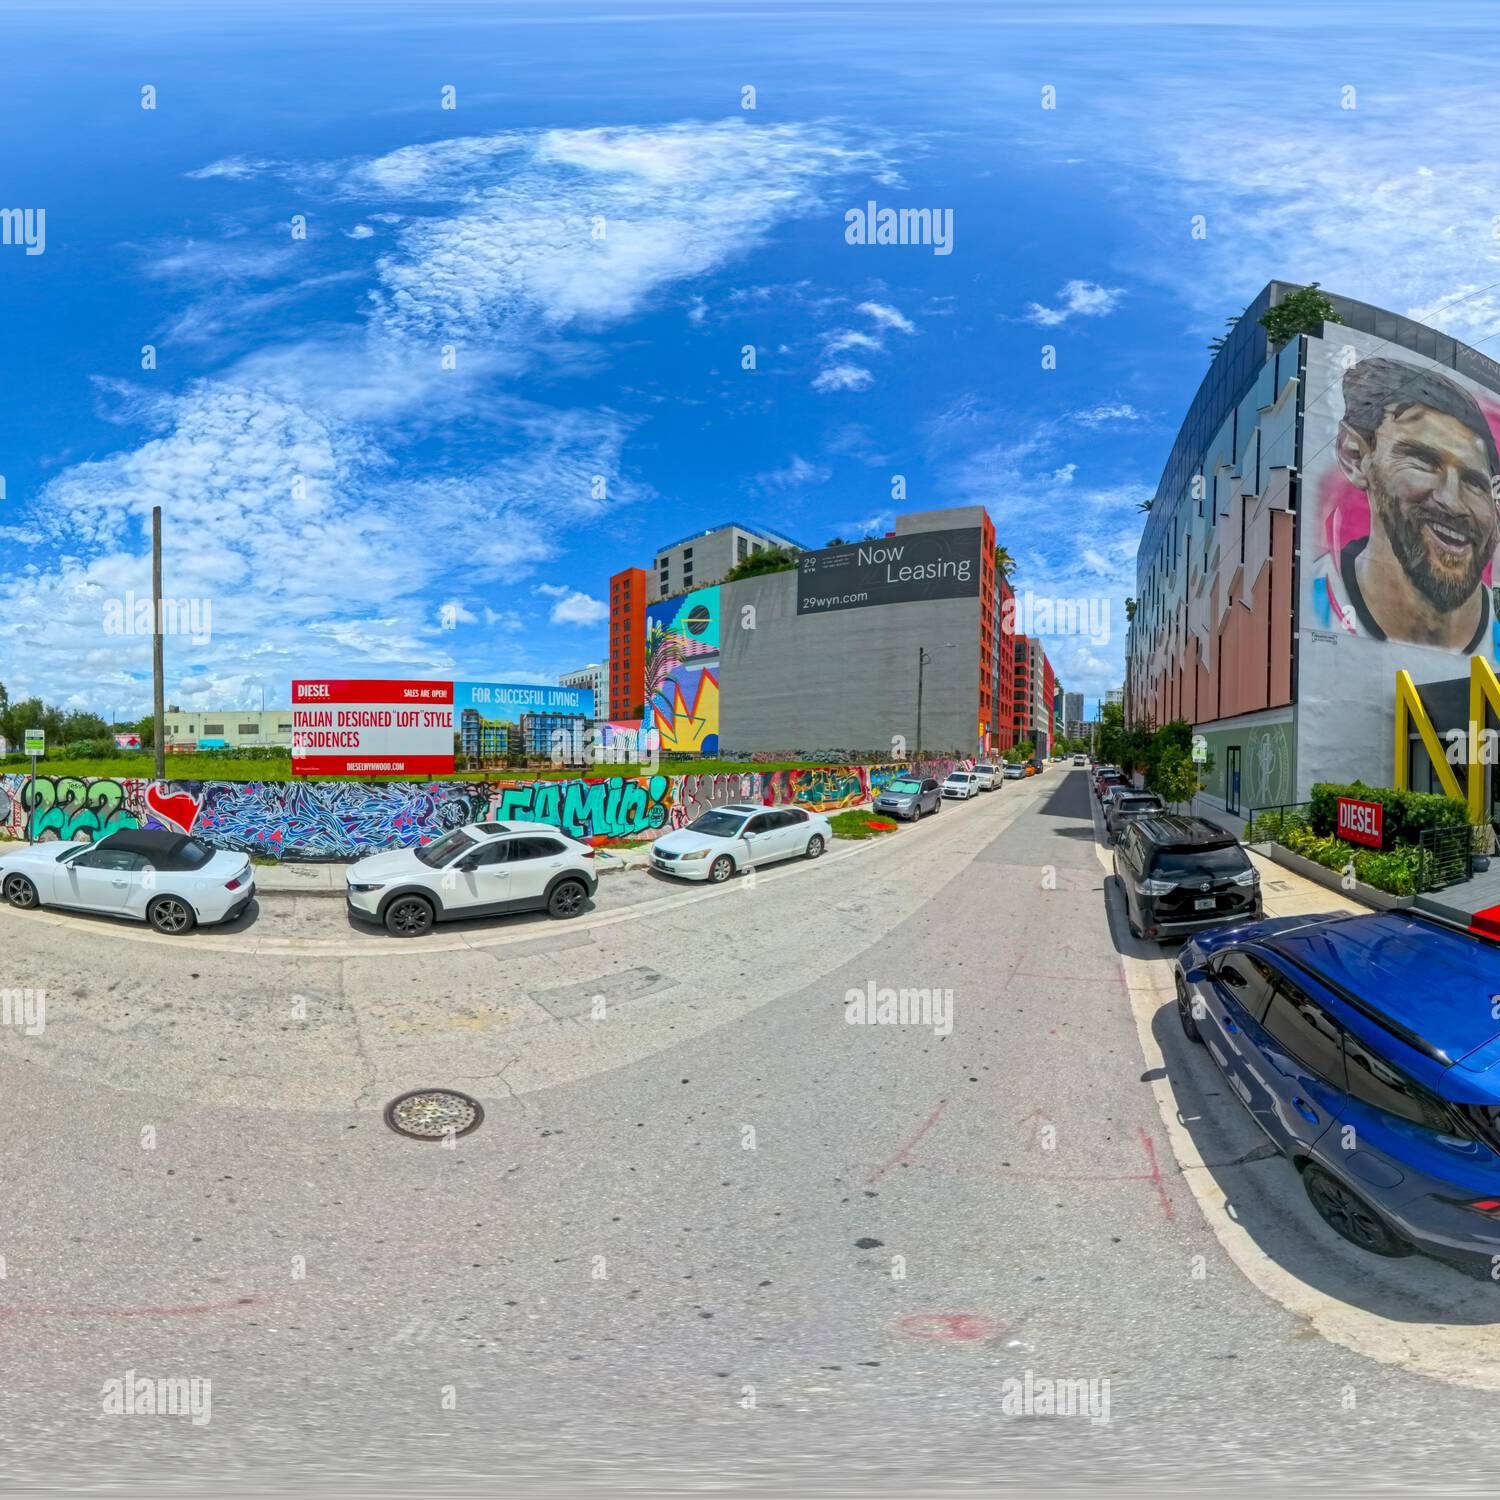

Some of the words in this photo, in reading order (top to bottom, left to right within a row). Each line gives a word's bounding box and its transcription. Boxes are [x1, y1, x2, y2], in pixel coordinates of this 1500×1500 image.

[804, 557, 817, 568] 29
[858, 546, 905, 567] Now
[887, 558, 971, 583] Leasing
[802, 591, 868, 609] 29wyn.com
[298, 685, 330, 697] DIESEL
[404, 689, 419, 698] SALES
[431, 690, 448, 698] OPEN!
[472, 688, 491, 703] FOR
[495, 690, 546, 706] SUCCESFUL
[548, 692, 579, 707] LIVING!
[293, 711, 333, 727] ITALIAN
[337, 711, 392, 727] DESIGNED
[424, 712, 453, 728] STYLE
[293, 731, 360, 748] RESIDENCES
[1339, 803, 1379, 837] DIESEL
